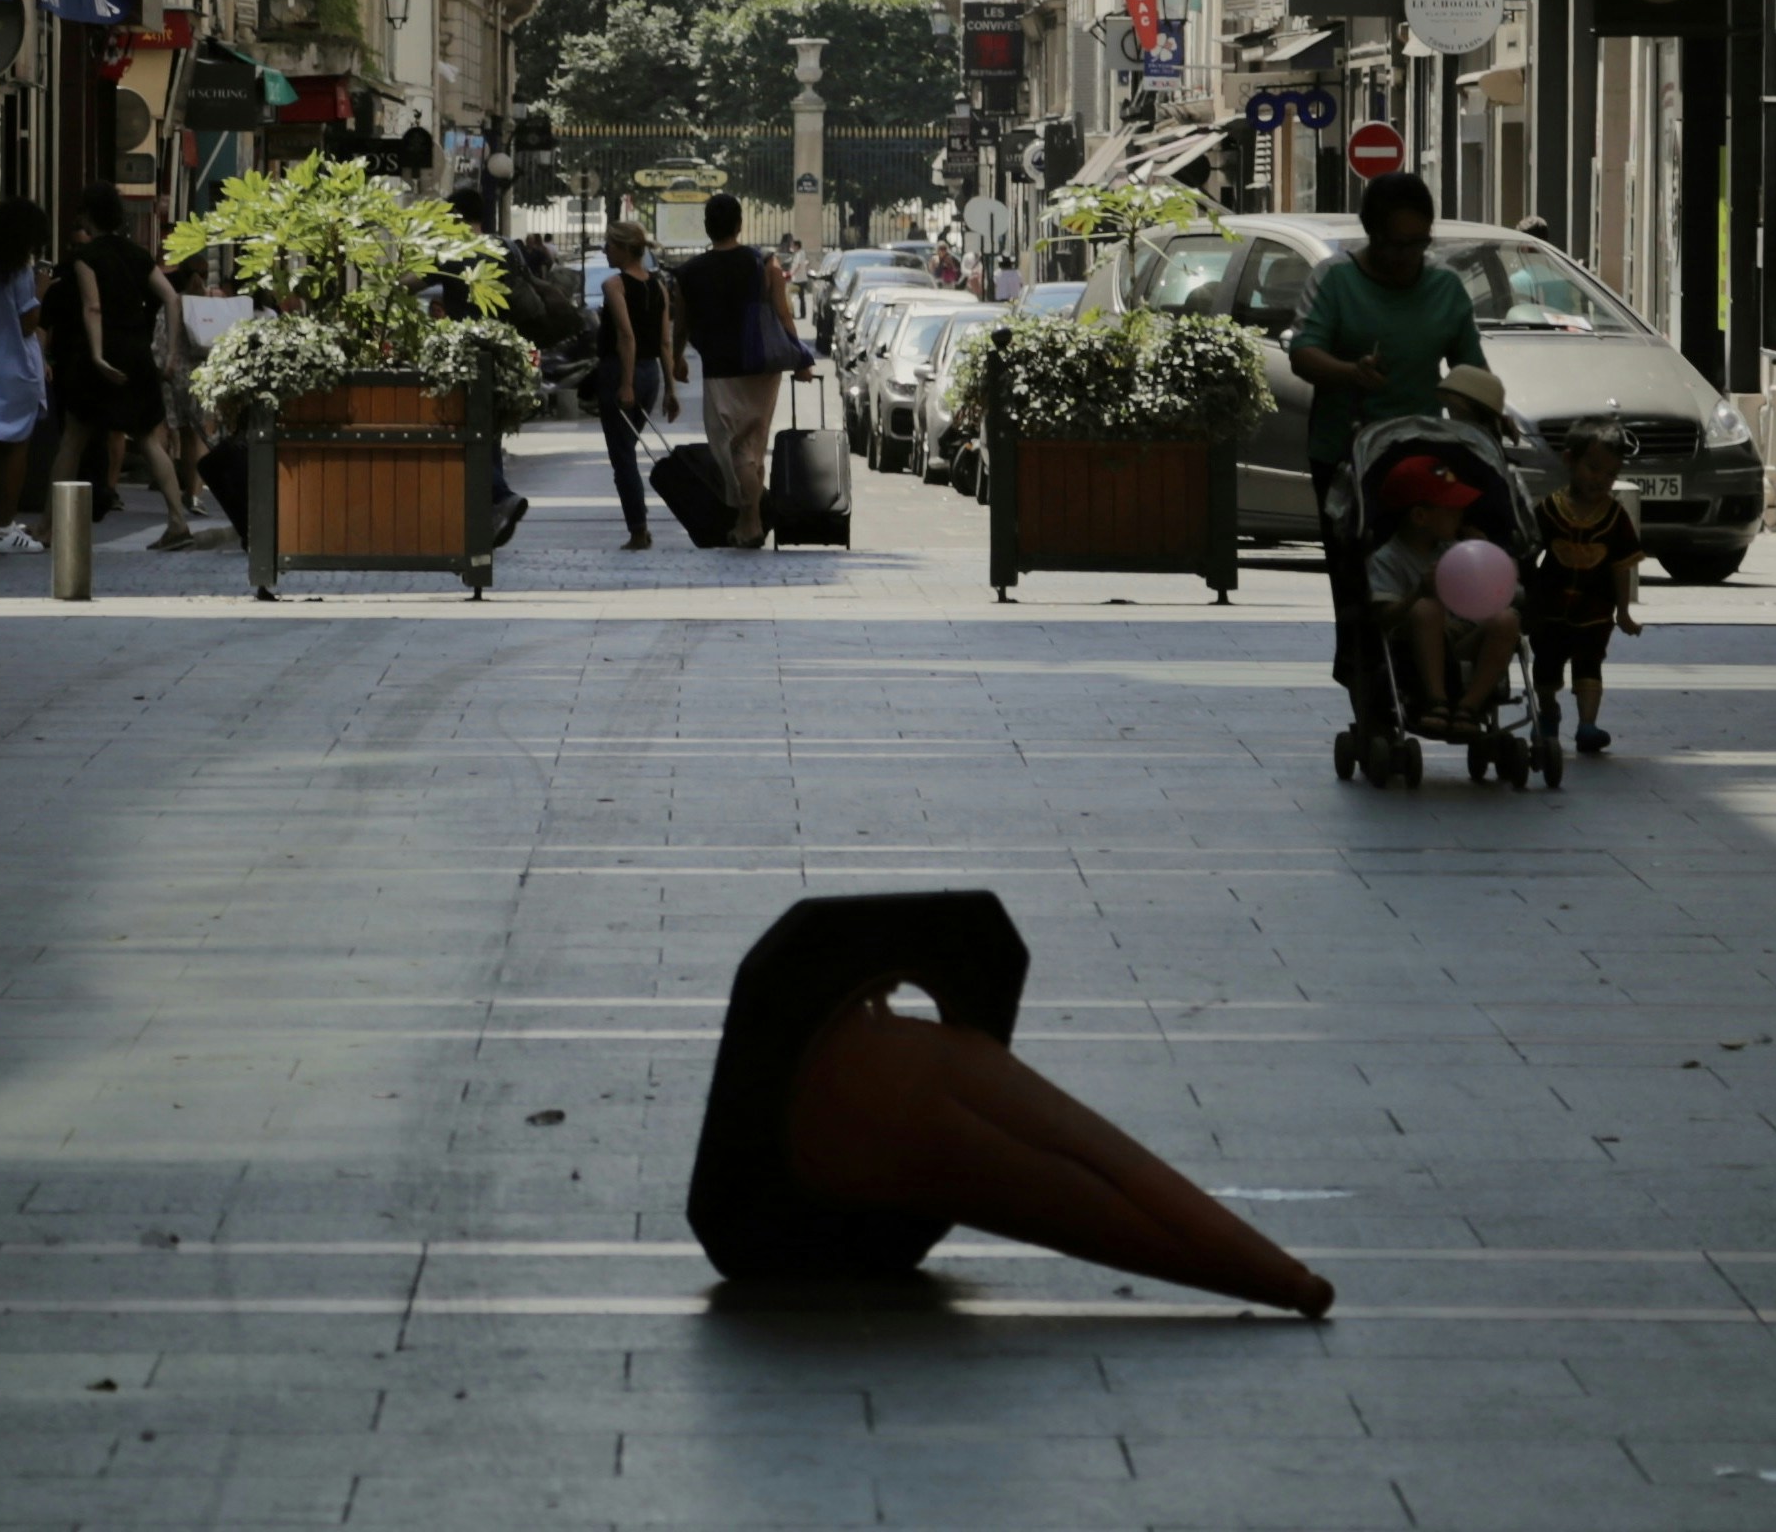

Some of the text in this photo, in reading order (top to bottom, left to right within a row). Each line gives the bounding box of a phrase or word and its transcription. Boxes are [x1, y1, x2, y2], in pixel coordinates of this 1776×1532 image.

[1432, 0, 1497, 9] CHOCOLAT
[983, 7, 1006, 19] LES
[966, 20, 1021, 32] CONVIVES
[1659, 478, 1679, 496] 75
